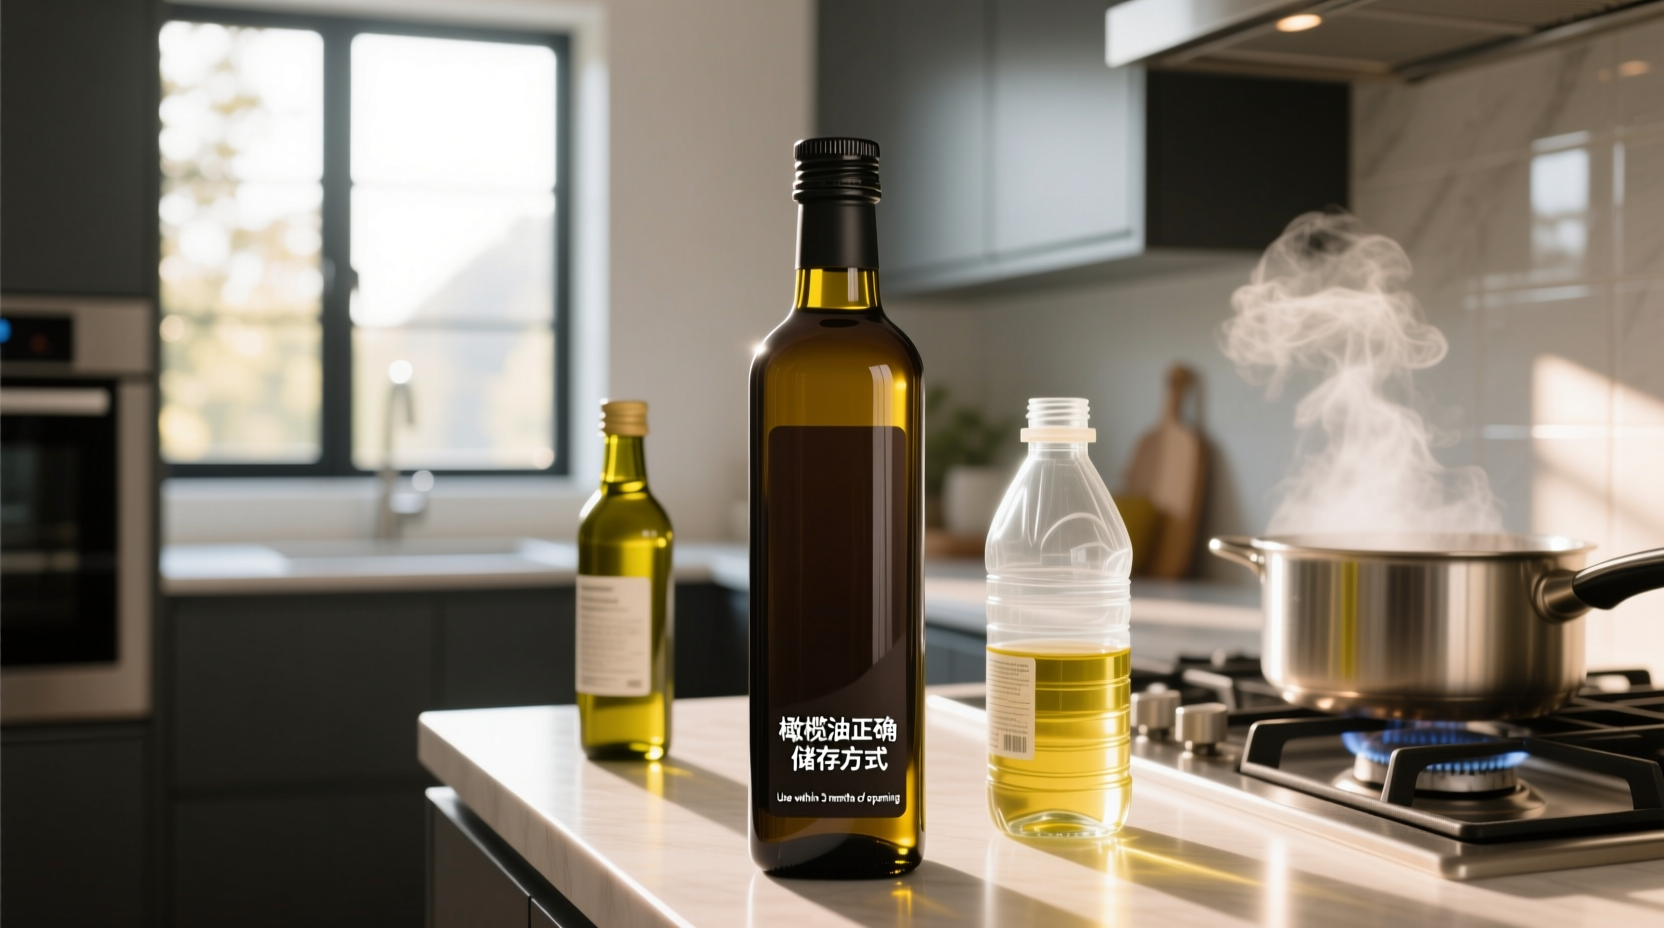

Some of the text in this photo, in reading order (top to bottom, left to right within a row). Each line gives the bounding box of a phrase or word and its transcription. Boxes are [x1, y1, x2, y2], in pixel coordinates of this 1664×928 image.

[778, 715, 898, 743] 橄榄油正确
[790, 744, 889, 772] 储存方式
